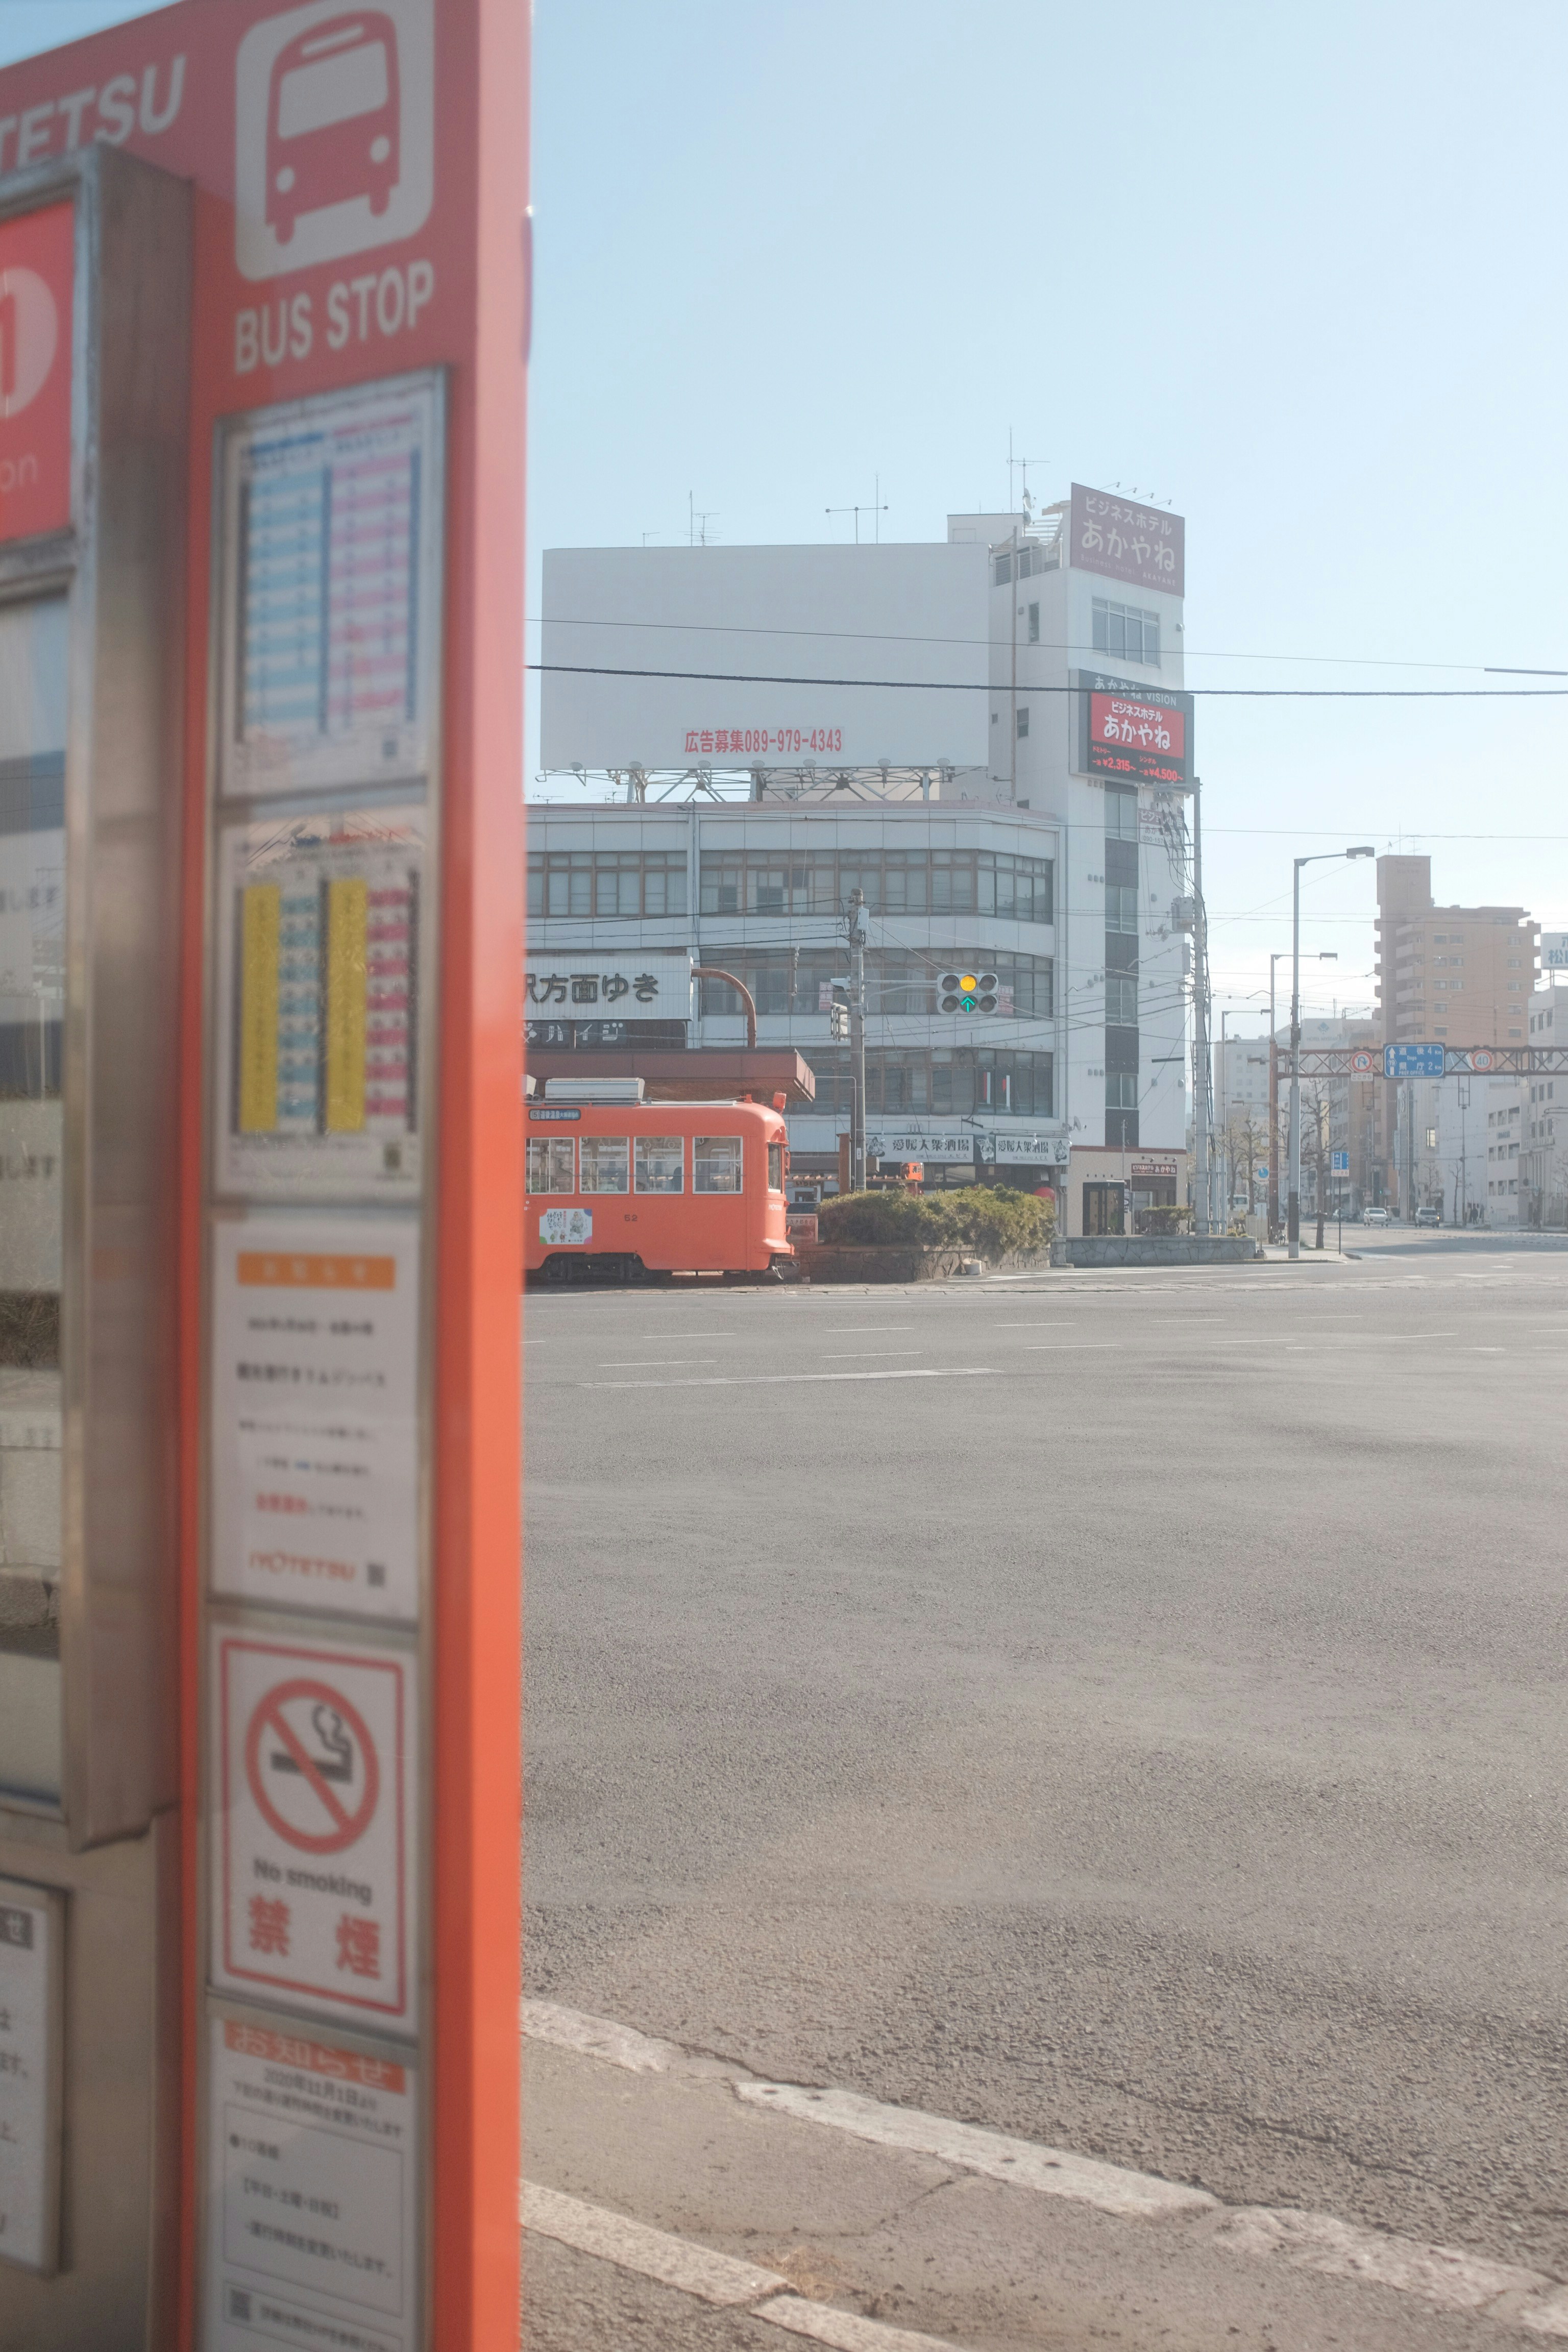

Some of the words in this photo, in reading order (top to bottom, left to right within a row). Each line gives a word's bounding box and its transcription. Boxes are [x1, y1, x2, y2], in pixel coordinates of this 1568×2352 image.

[236, 292, 312, 374] BUS
[327, 259, 434, 350] STOP
[1086, 496, 1172, 535] ビジネスホテル
[1081, 518, 1175, 572] あかやね
[1142, 571, 1175, 586] AKAYANE
[1146, 692, 1177, 706] VISION
[1111, 701, 1163, 723] ビジネスホテル
[685, 729, 842, 753] 広告募集089-979-4343
[1104, 714, 1171, 750] あかやね
[1548, 949, 1568, 965] 松
[1428, 1046, 1432, 1055] 4
[1428, 1062, 1433, 1071] 2
[1477, 1056, 1488, 1065] 40
[892, 1139, 969, 1152] 愛媛大衆酒場
[998, 1140, 1048, 1154] 愛媛大衆酒場
[1155, 1165, 1176, 1173] あかやね
[254, 1857, 281, 1883] No
[285, 1867, 373, 1907] smoking
[249, 1896, 380, 1980] 禁煙
[233, 2025, 392, 2089] お知らせ
